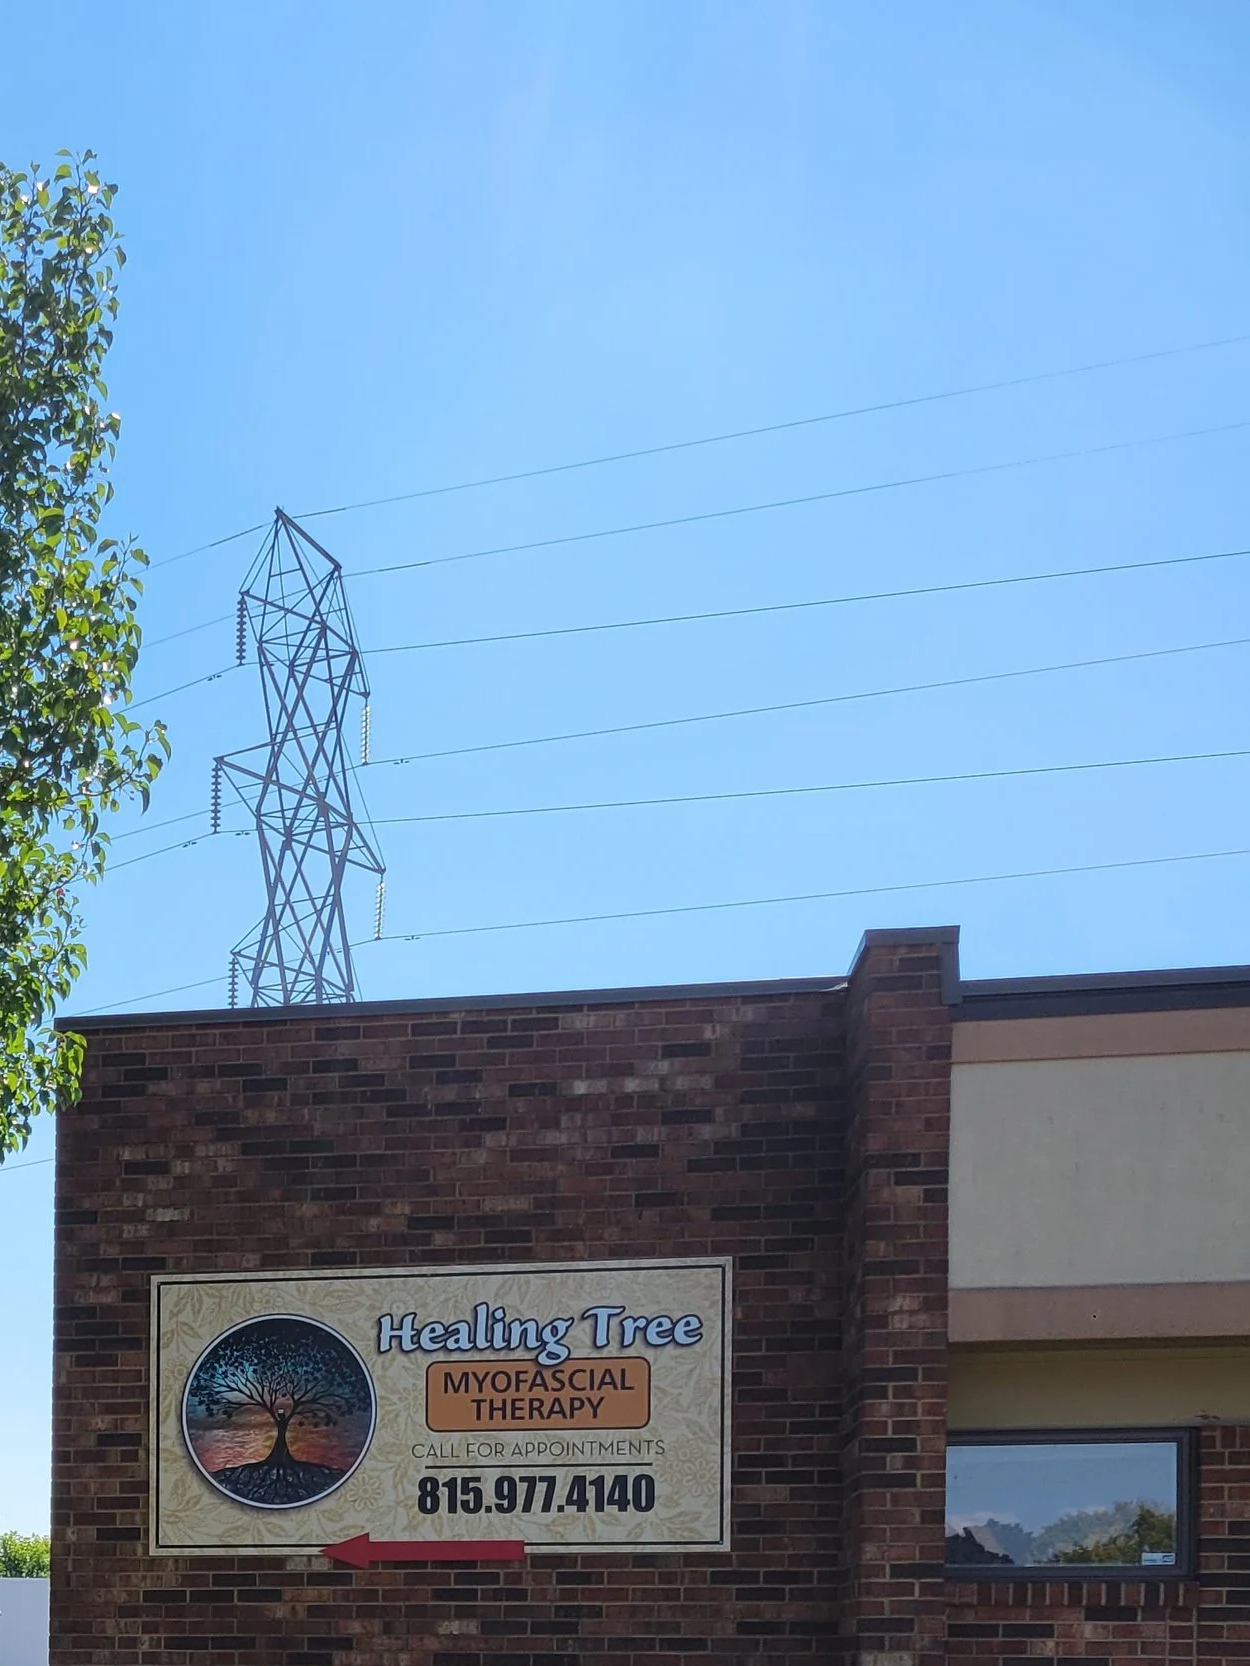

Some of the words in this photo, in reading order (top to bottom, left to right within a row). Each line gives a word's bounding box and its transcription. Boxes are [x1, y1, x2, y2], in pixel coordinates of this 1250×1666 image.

[377, 1301, 575, 1367] Healing
[581, 1305, 704, 1349] Tree
[442, 1367, 636, 1394] MYOFASCIAL
[470, 1396, 606, 1422] THERAPY
[411, 1443, 461, 1460] CALL
[466, 1442, 506, 1459] FOR
[510, 1439, 667, 1458] APPOINTMENTS
[417, 1473, 657, 1515] 815.977.4140
